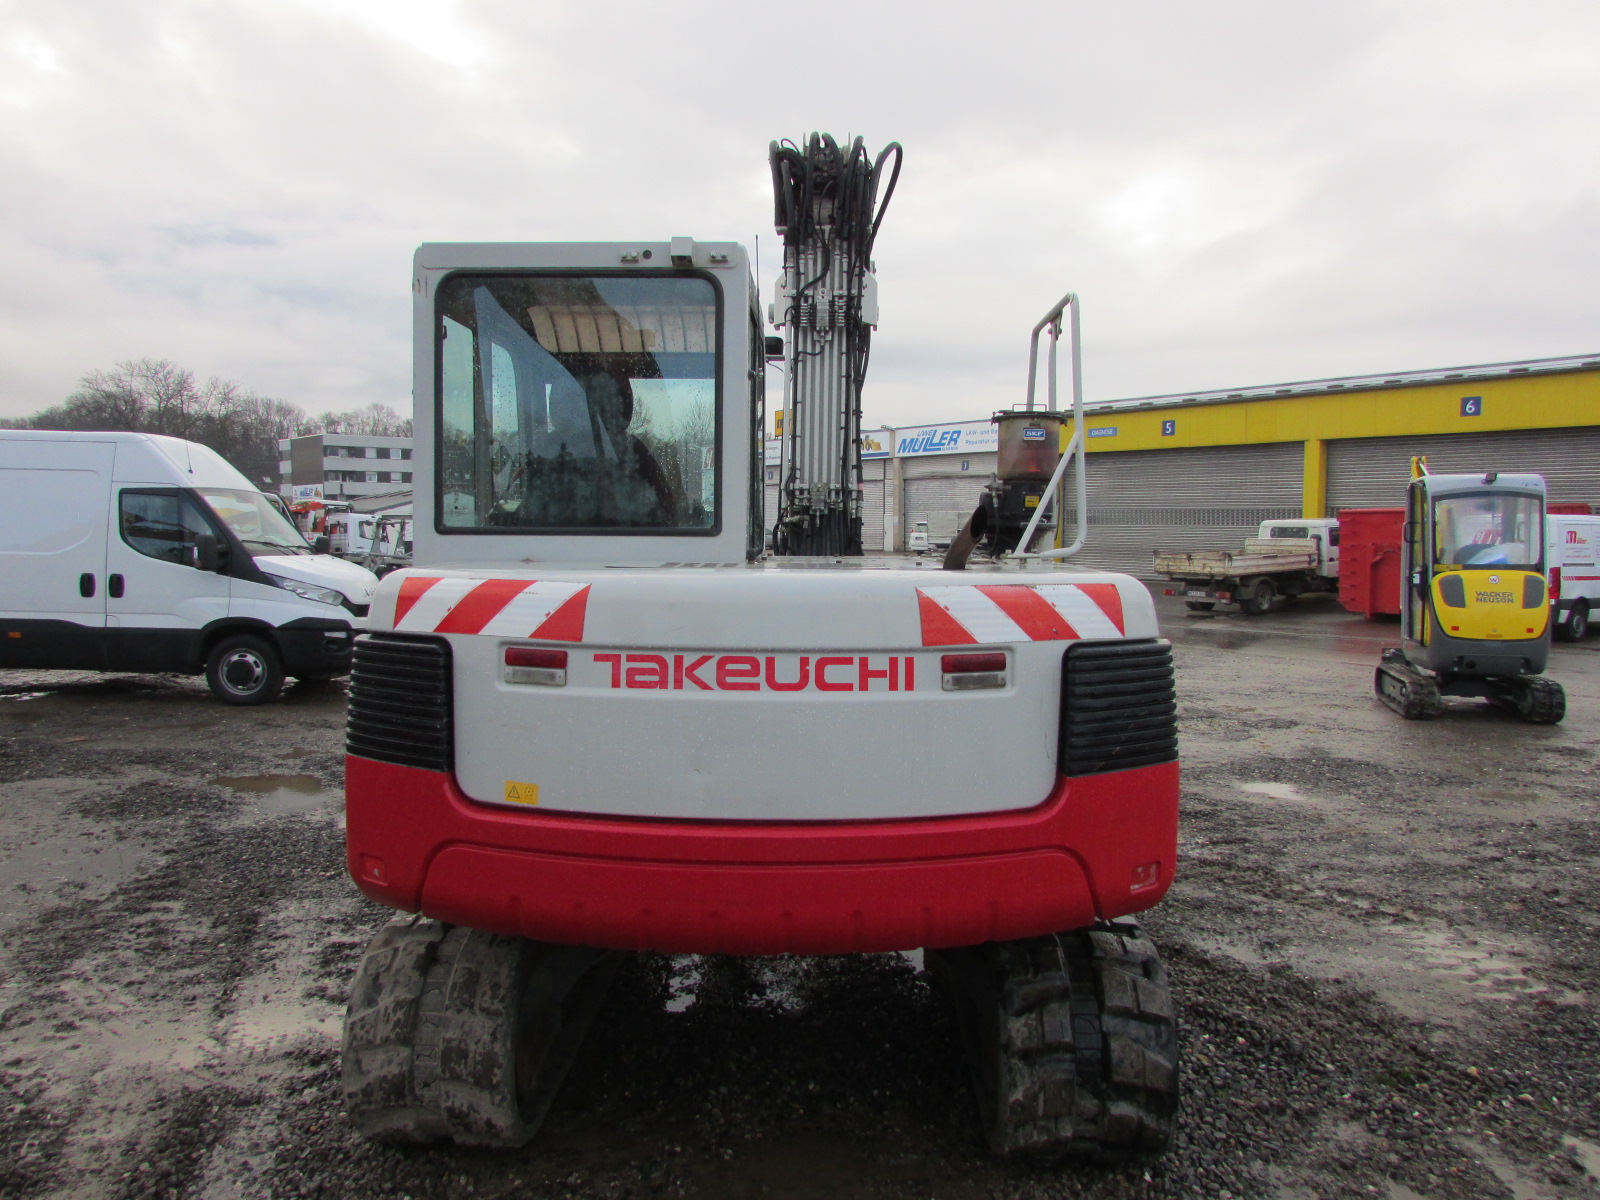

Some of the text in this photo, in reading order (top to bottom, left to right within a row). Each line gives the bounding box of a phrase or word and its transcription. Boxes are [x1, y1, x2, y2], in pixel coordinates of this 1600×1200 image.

[1465, 400, 1475, 413] 6
[1165, 423, 1171, 433] 5
[963, 462, 967, 470] 3
